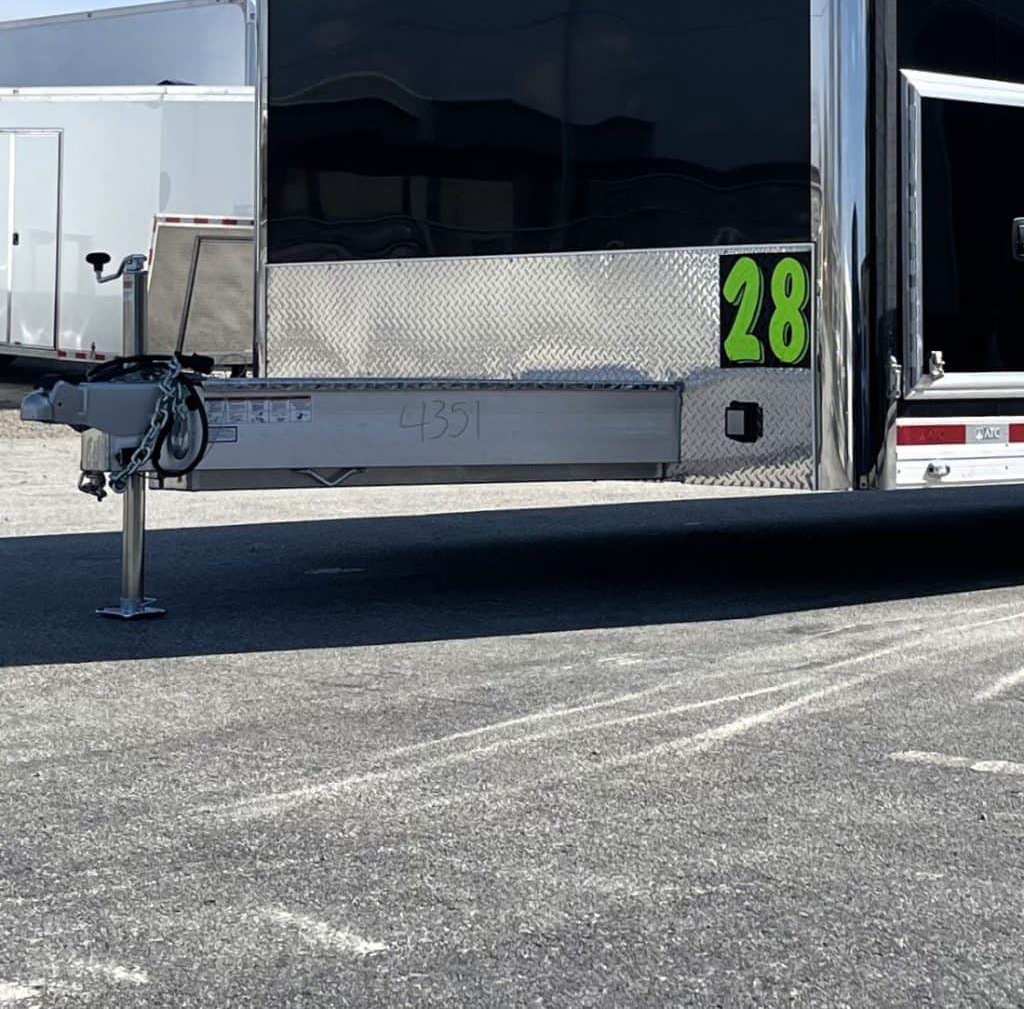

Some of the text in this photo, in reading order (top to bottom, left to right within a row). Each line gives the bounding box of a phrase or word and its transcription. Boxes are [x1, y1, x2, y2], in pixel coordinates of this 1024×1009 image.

[723, 256, 810, 364] 28
[400, 399, 480, 443] 4351
[984, 426, 1001, 438] ATC
